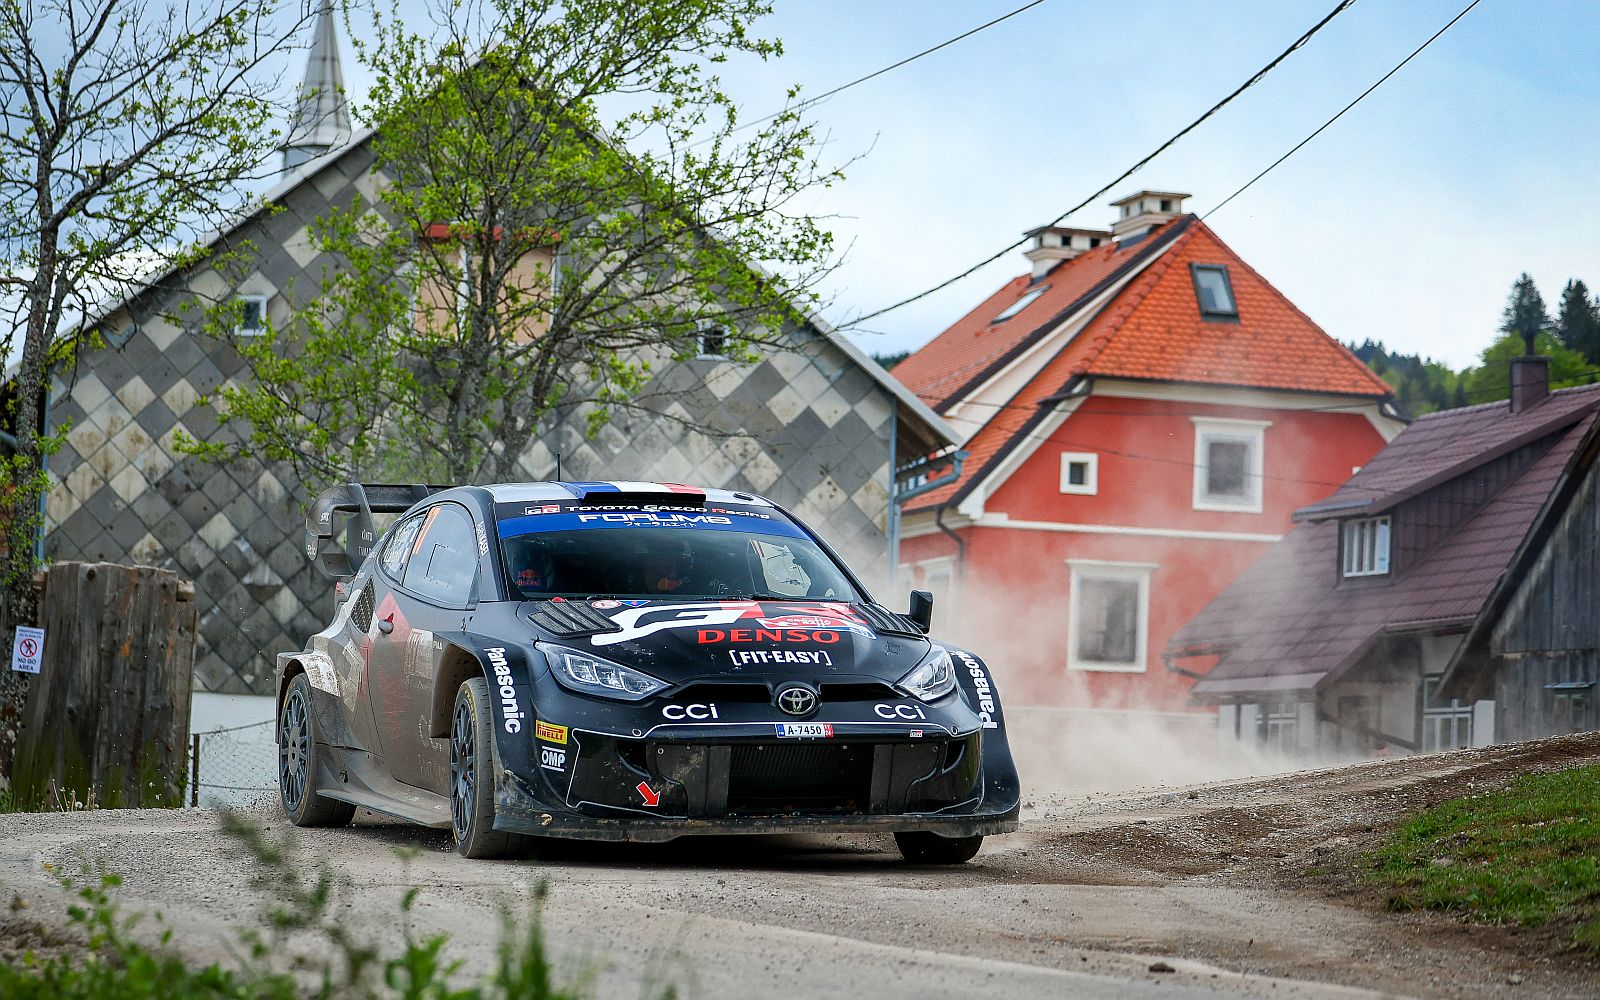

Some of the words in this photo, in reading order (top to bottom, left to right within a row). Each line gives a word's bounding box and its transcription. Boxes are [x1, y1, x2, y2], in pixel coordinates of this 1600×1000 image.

[578, 513, 733, 525] FORUM8
[697, 629, 841, 645] DENSO
[537, 723, 564, 741] PIRELLI
[788, 725, 822, 735] A-7450
[541, 750, 566, 767] OMP
